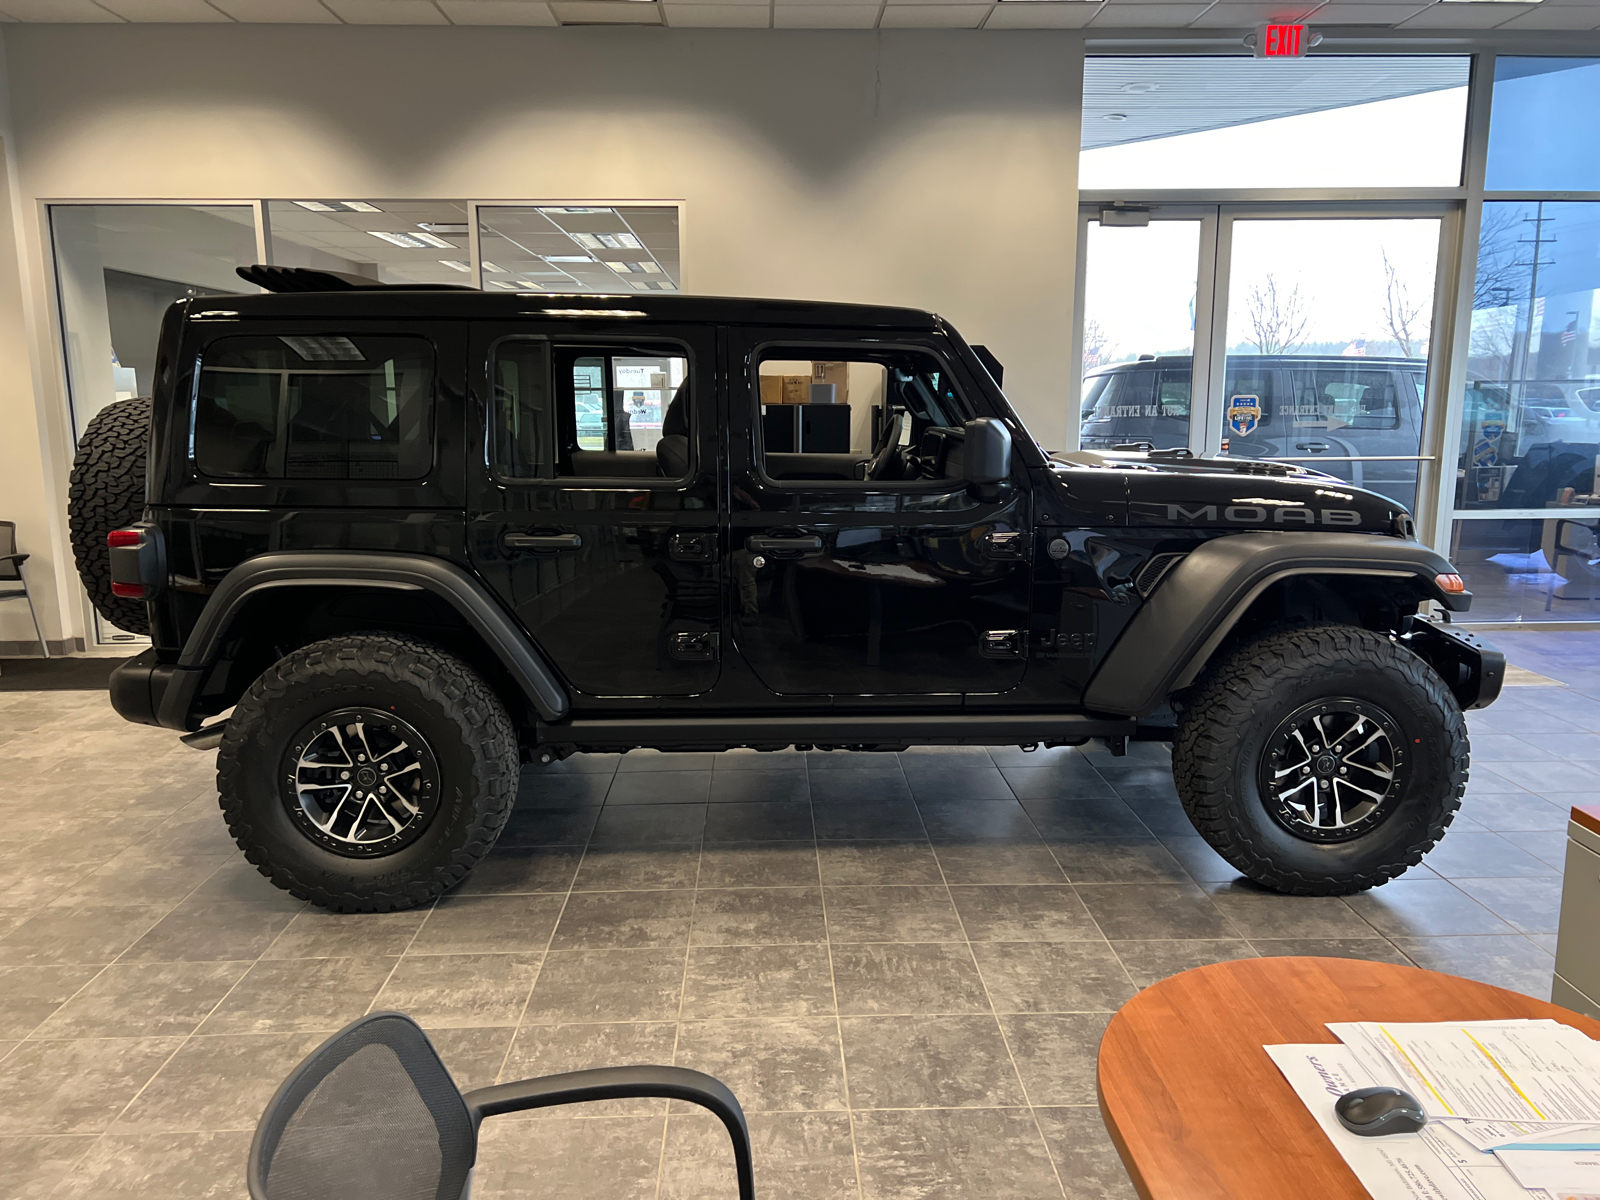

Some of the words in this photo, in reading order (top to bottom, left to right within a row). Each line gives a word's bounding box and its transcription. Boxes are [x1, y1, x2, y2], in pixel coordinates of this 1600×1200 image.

[1265, 25, 1303, 55] EXIT
[1167, 504, 1362, 526] MOAB
[1040, 628, 1097, 650] Jeep
[1306, 1055, 1343, 1096] Owners
